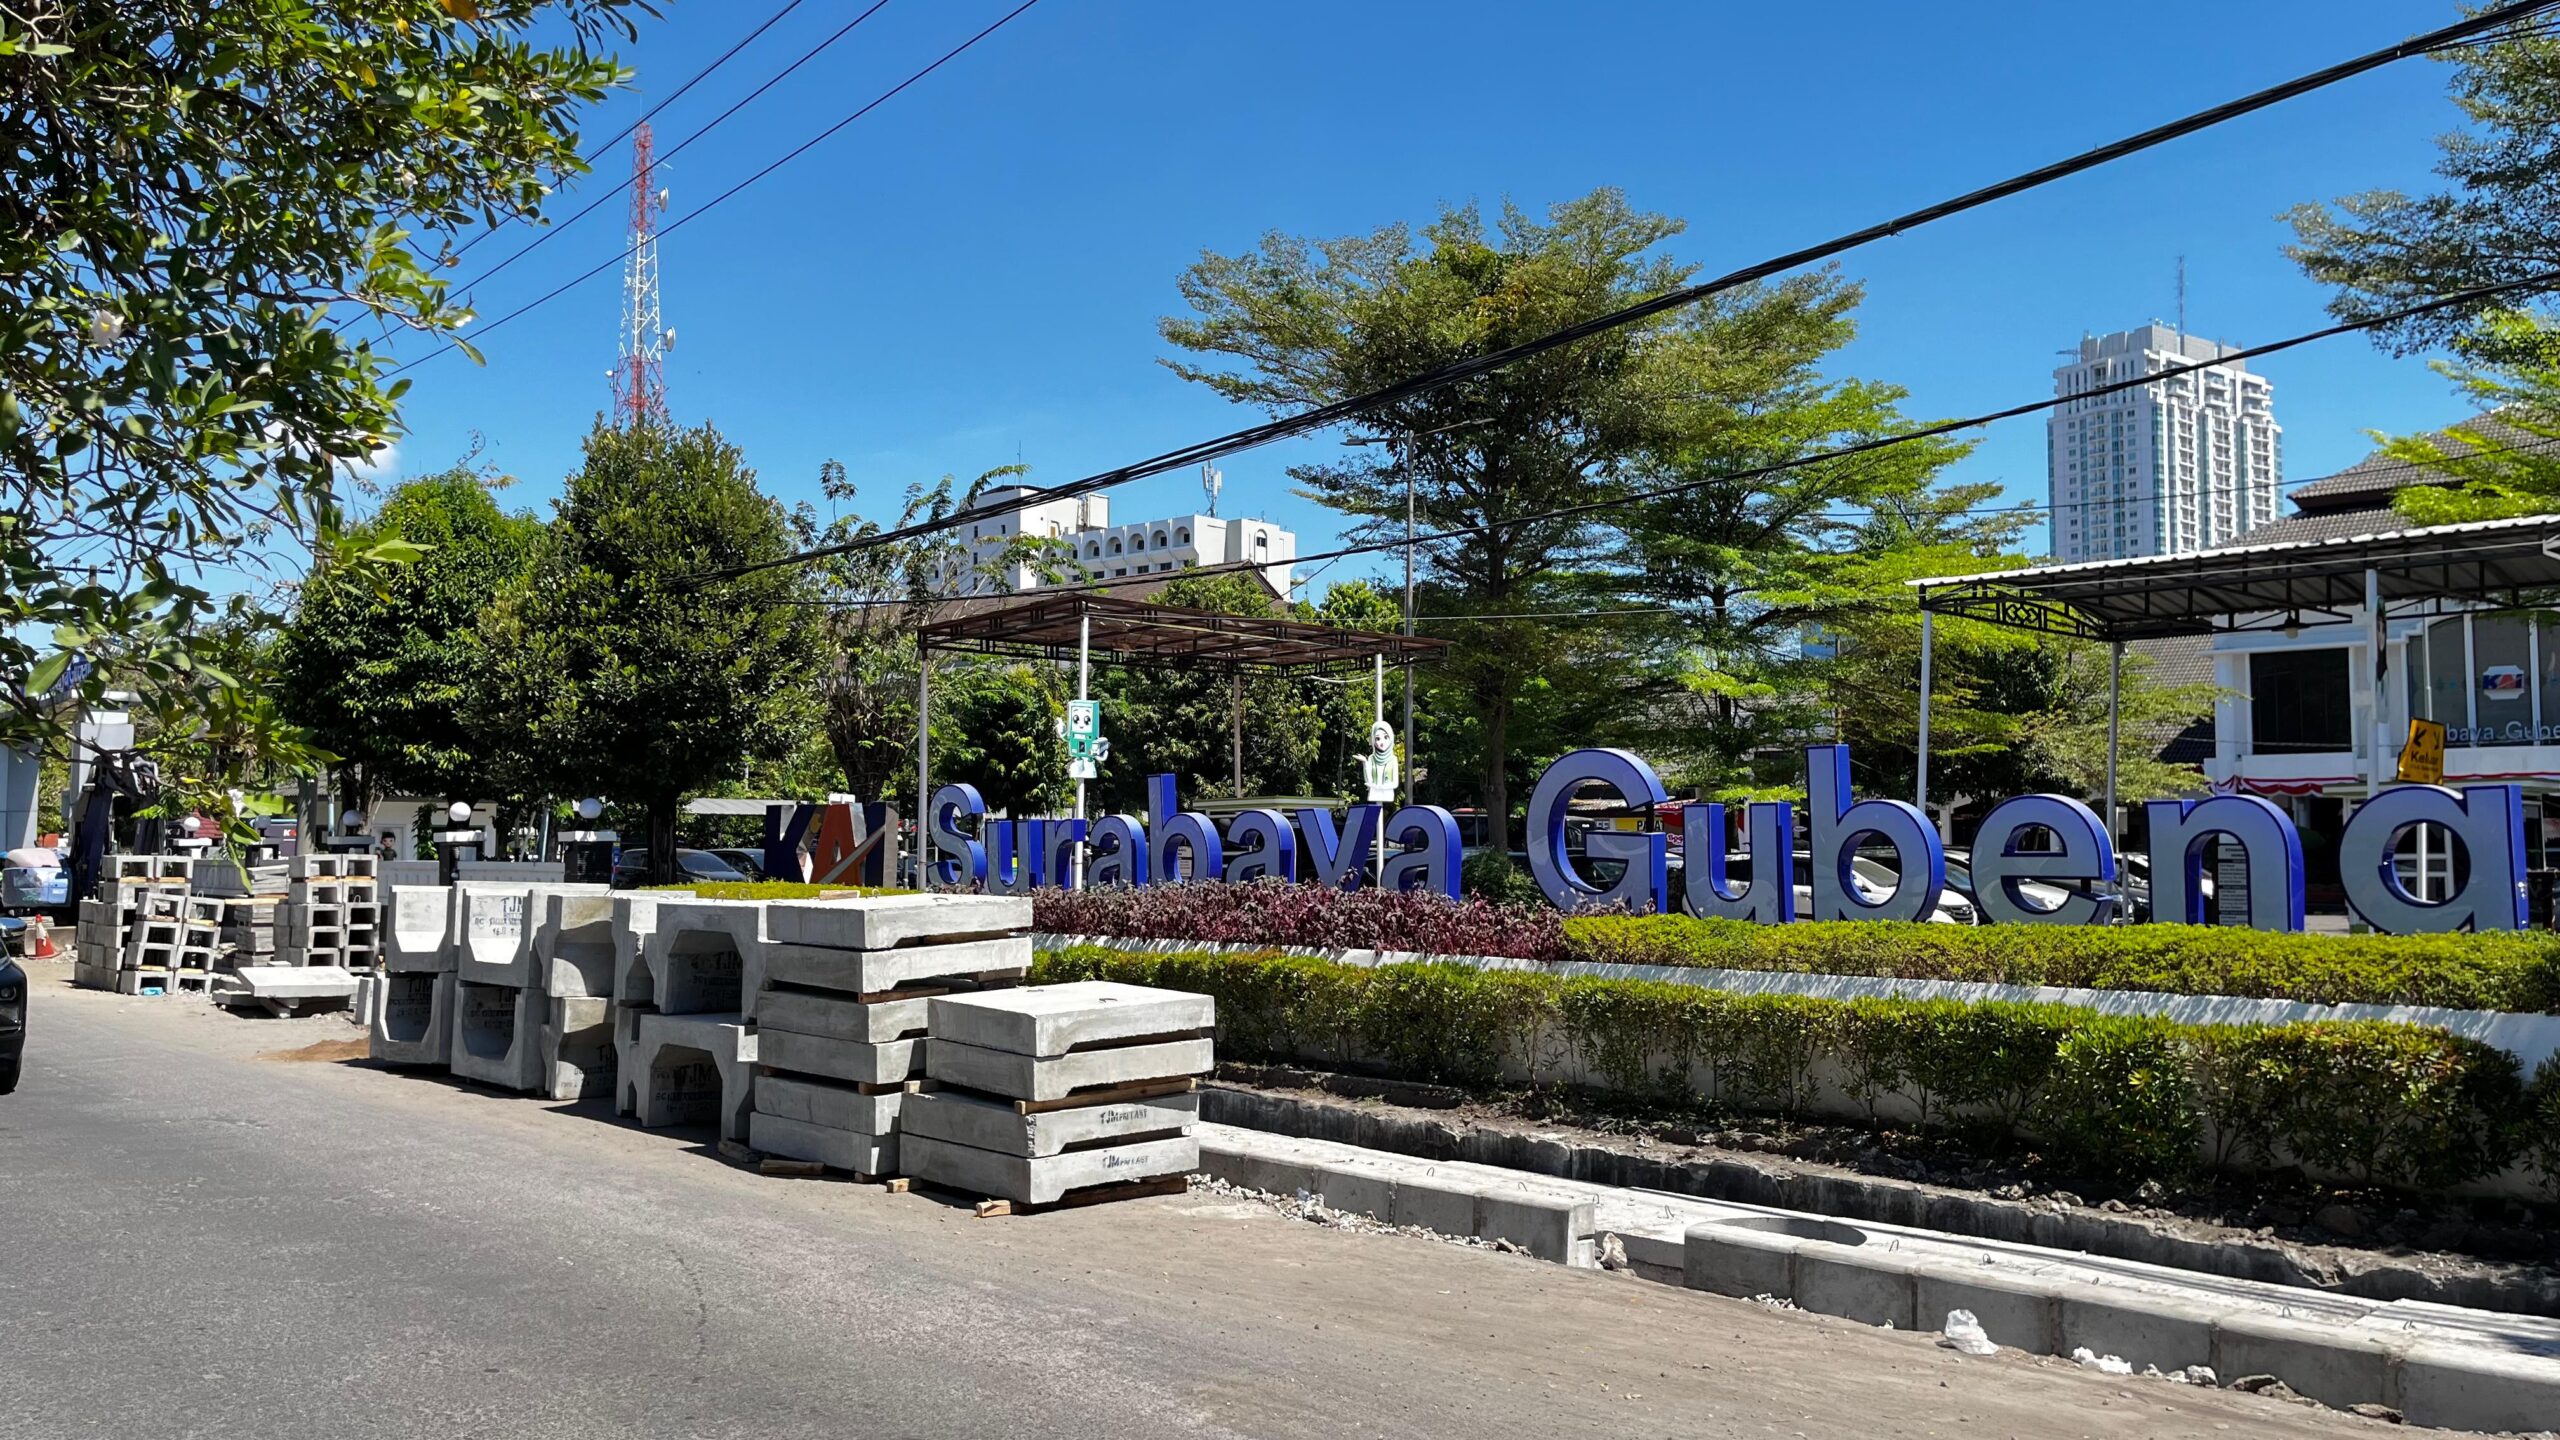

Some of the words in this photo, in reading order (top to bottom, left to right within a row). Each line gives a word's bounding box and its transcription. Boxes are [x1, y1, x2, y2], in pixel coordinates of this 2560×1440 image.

[2483, 673, 2523, 690] KAI
[764, 801, 900, 888] KAI
[928, 774, 1461, 902] Surabaya
